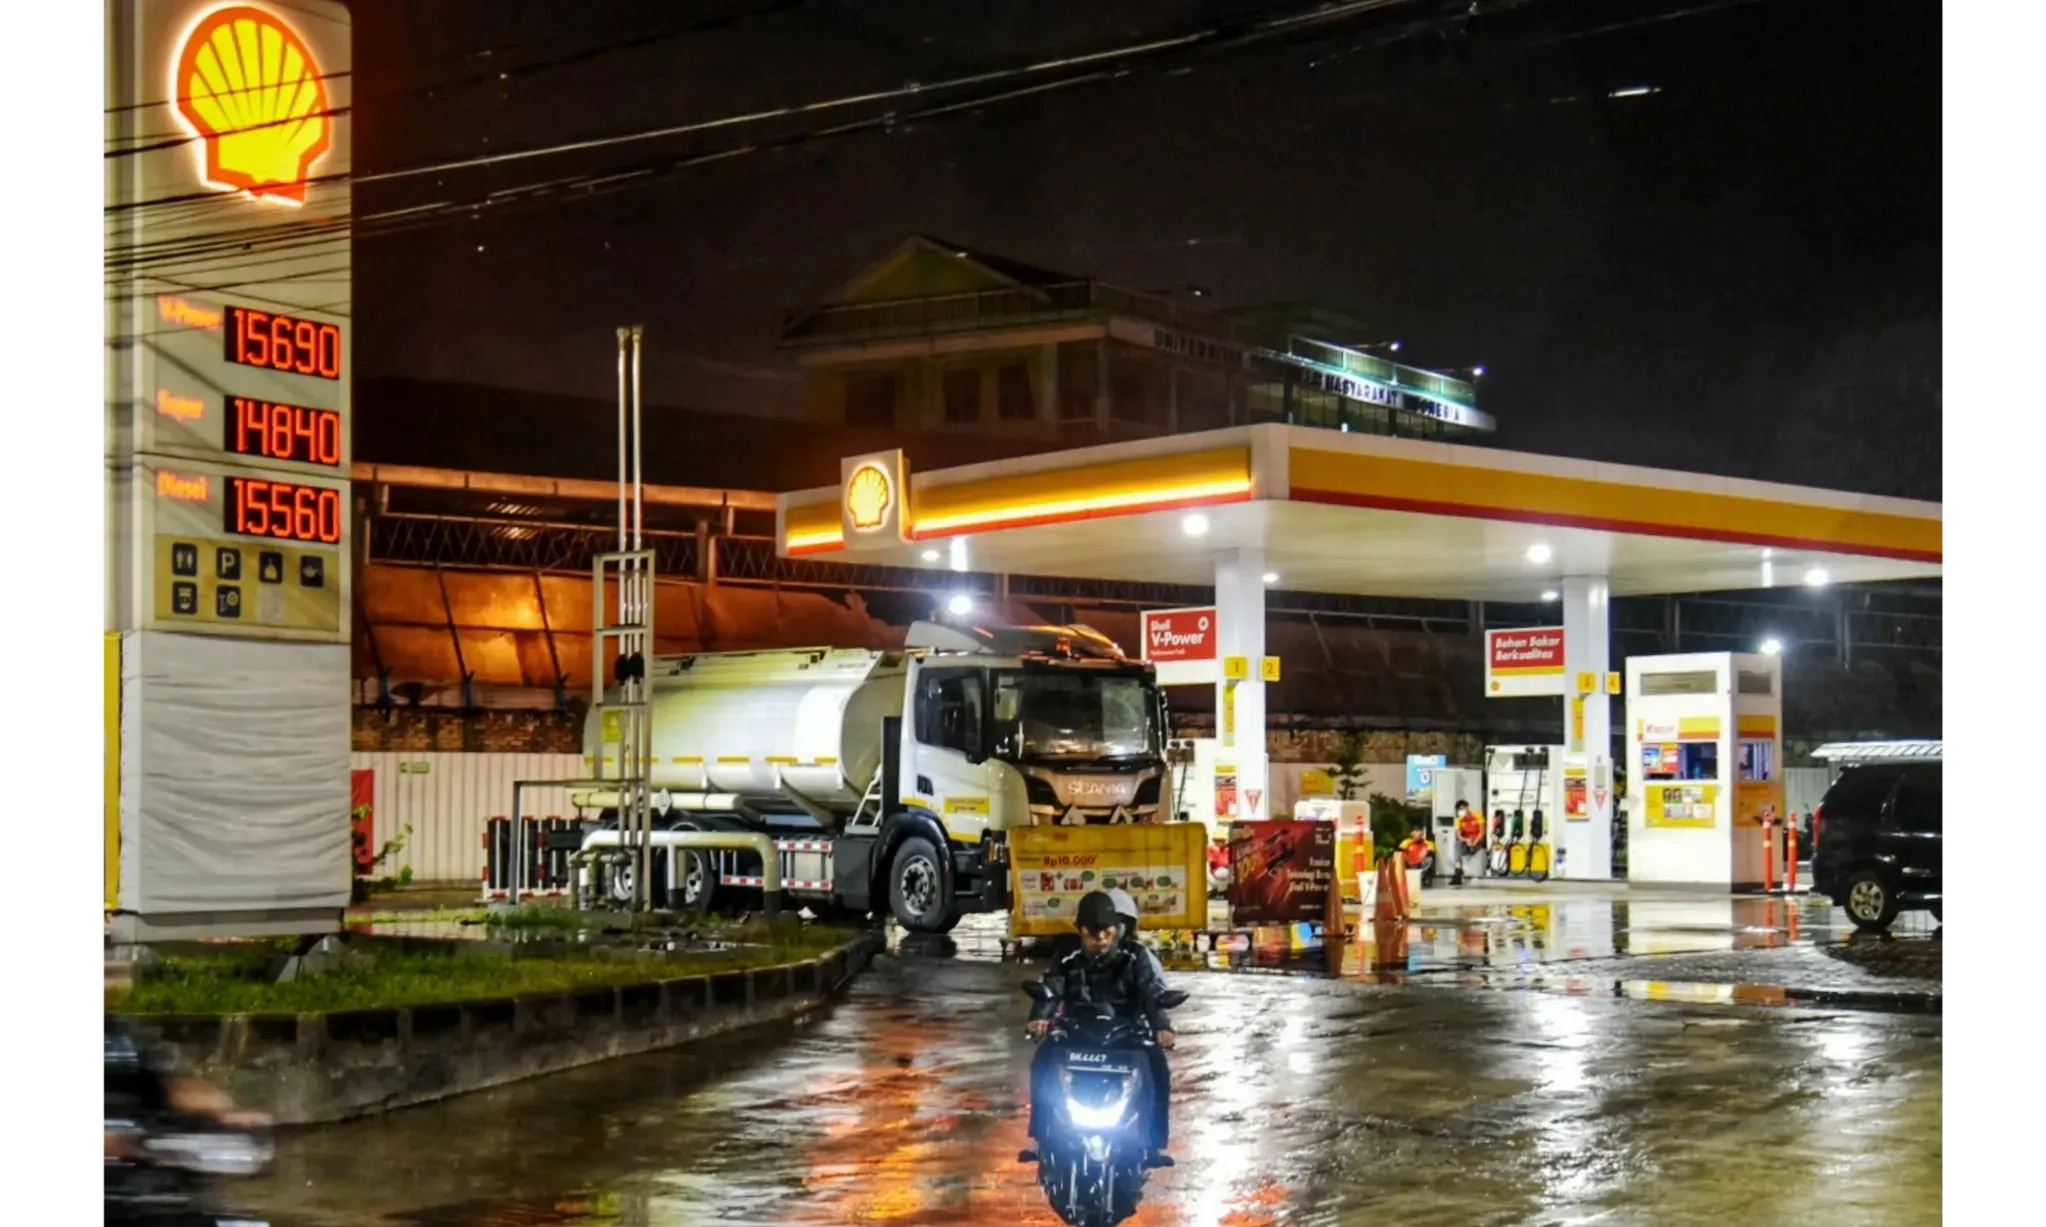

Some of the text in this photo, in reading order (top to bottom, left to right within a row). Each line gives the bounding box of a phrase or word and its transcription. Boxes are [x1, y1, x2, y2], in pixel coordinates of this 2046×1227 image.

[234, 308, 340, 378] 15690
[234, 397, 340, 465] 14840
[156, 470, 208, 500] Diesel
[234, 479, 340, 542] 15560
[1151, 619, 1171, 632] Shell
[1151, 631, 1205, 647] V-Power
[1495, 634, 1561, 649] Bahan Bakar
[1495, 649, 1554, 661] Berkualitas
[1067, 780, 1126, 795] SCANIA
